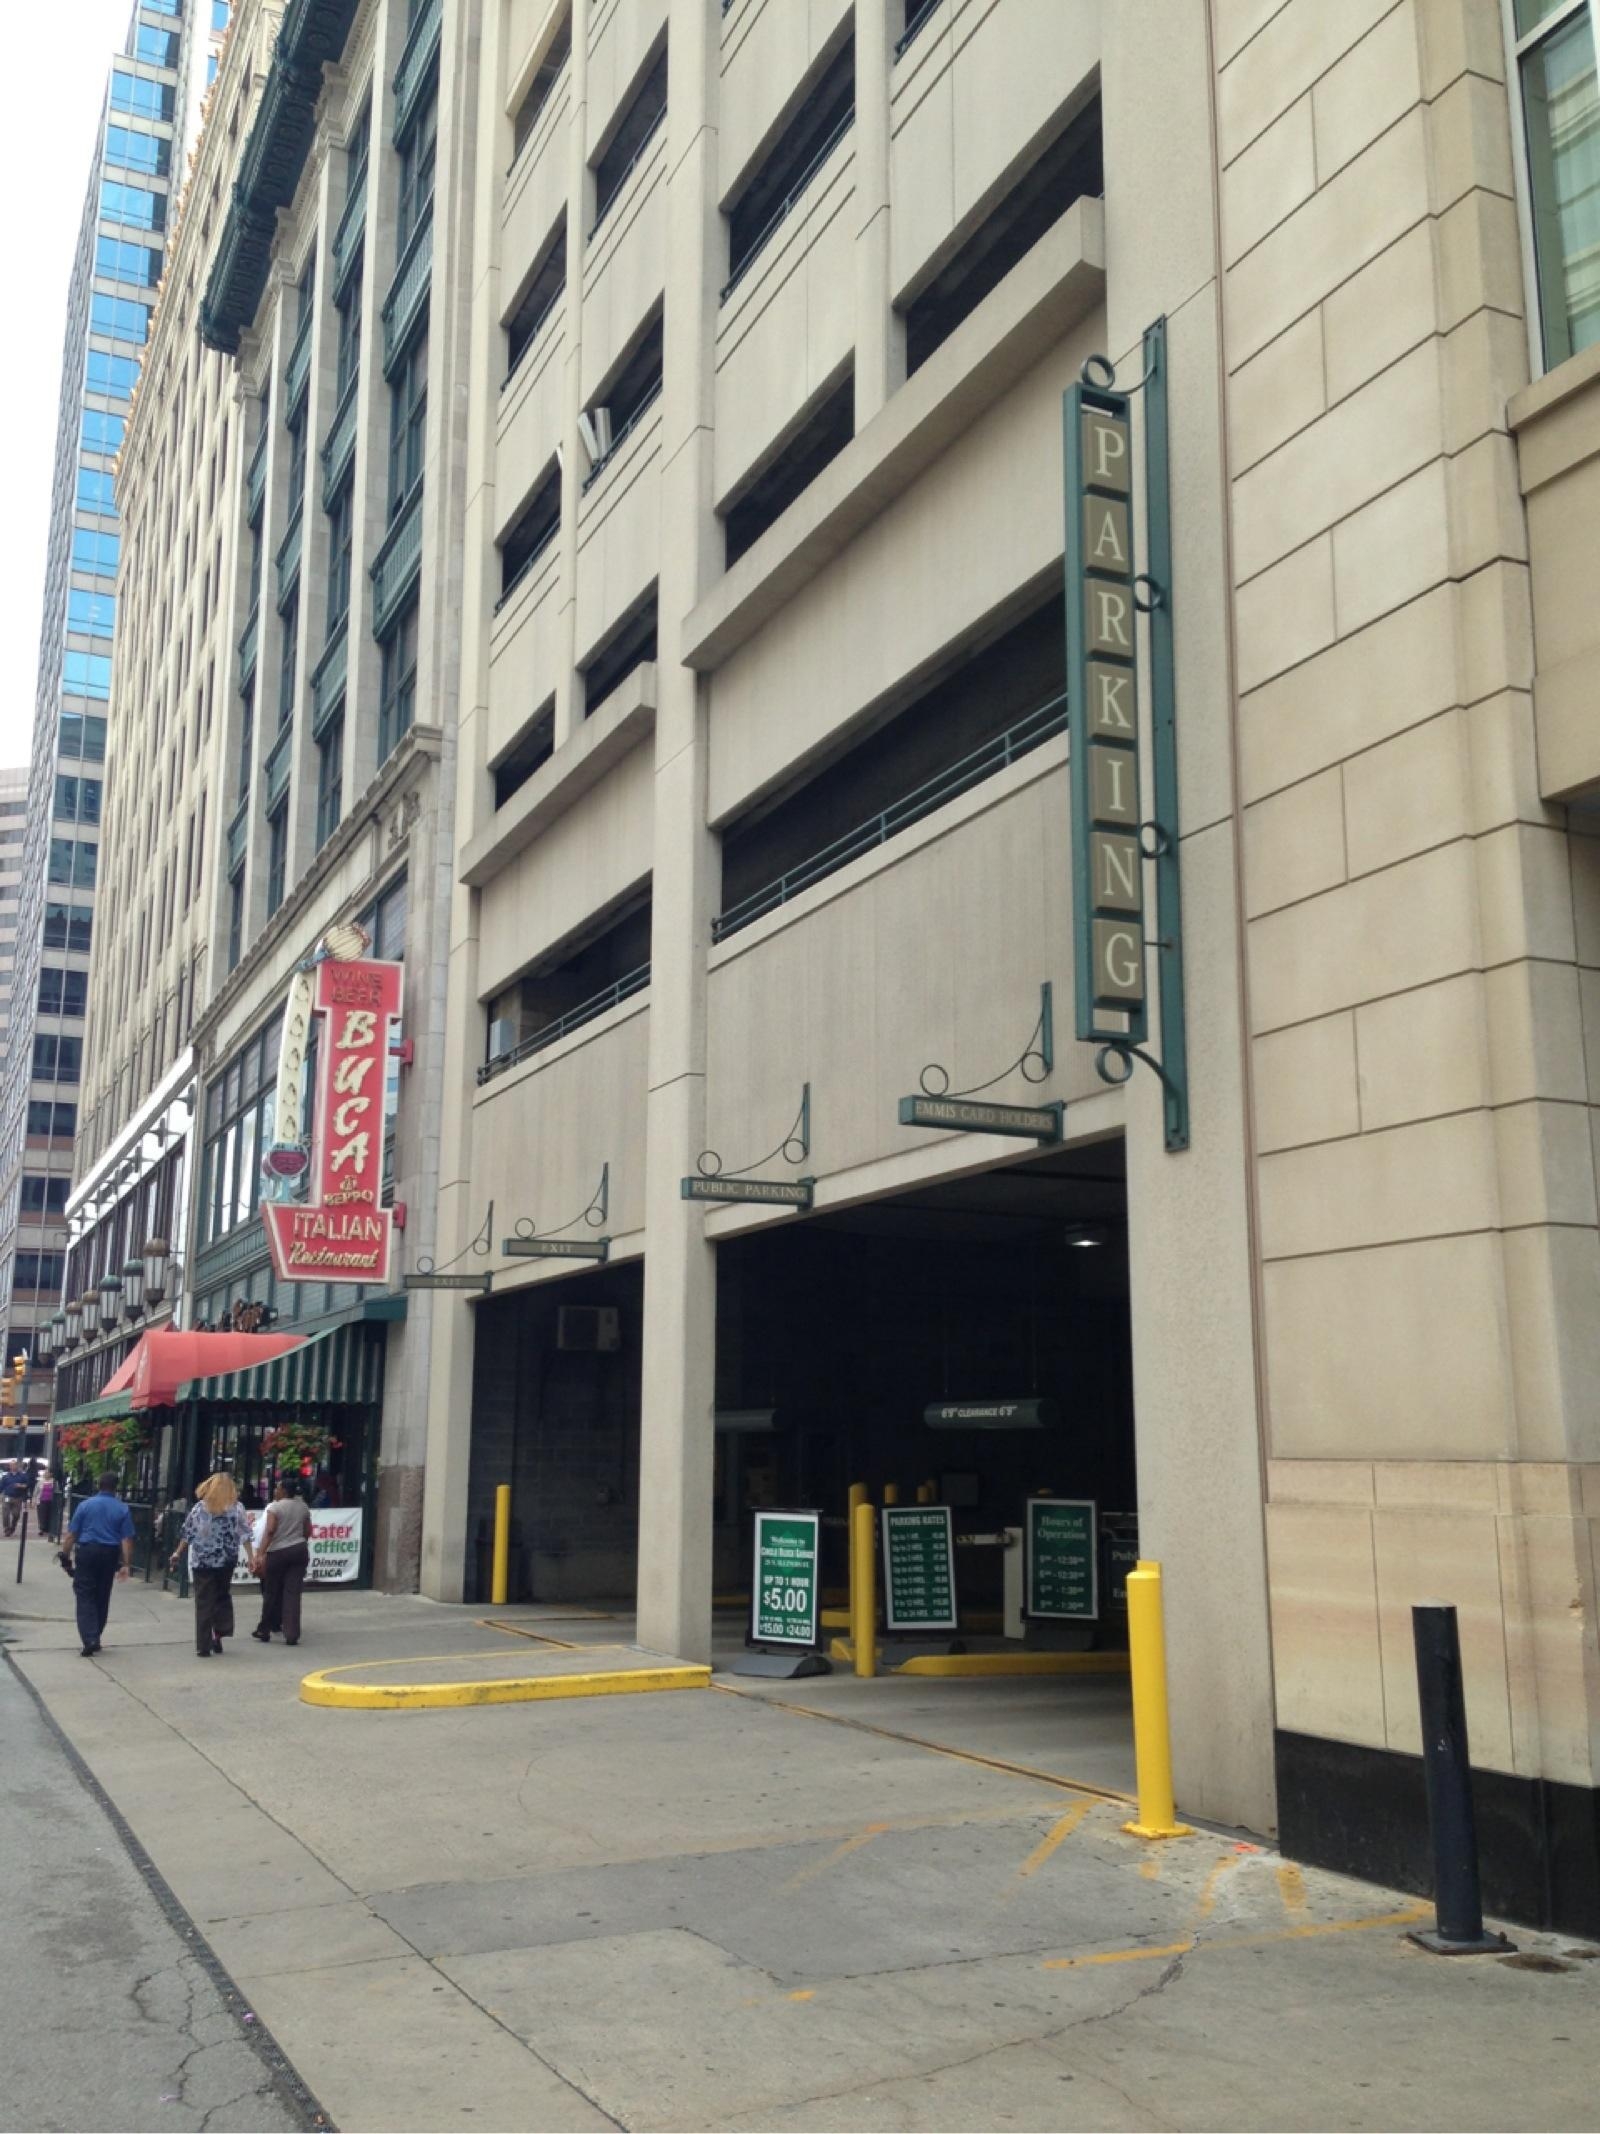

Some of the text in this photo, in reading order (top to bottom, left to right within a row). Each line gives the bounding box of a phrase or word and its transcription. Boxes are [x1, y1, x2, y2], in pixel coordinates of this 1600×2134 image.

[1094, 426, 1138, 988] PARKING
[331, 968, 383, 987] WINE
[331, 986, 382, 1006] BEER
[331, 1009, 378, 1174] BUCA
[915, 1101, 1053, 1129] EMMIS CARD HOLDERS
[694, 1181, 806, 1198] PUBLIC PARKING
[324, 1190, 374, 1206] BEPPO
[294, 1211, 383, 1241] ITALIAN
[288, 1240, 379, 1268] Restaurant
[541, 1244, 573, 1253] EXIT
[434, 1278, 462, 1286] EXIT
[890, 1514, 945, 1527] PARKING RATES
[1041, 1516, 1083, 1527] Hours of
[311, 1524, 353, 1539] Cater
[1037, 1528, 1086, 1541] Operation
[311, 1557, 349, 1568] Dinner
[764, 1575, 774, 1585] UP
[774, 1575, 783, 1586] TO
[791, 1577, 809, 1588] HOUR
[763, 1587, 807, 1612] $5.00
